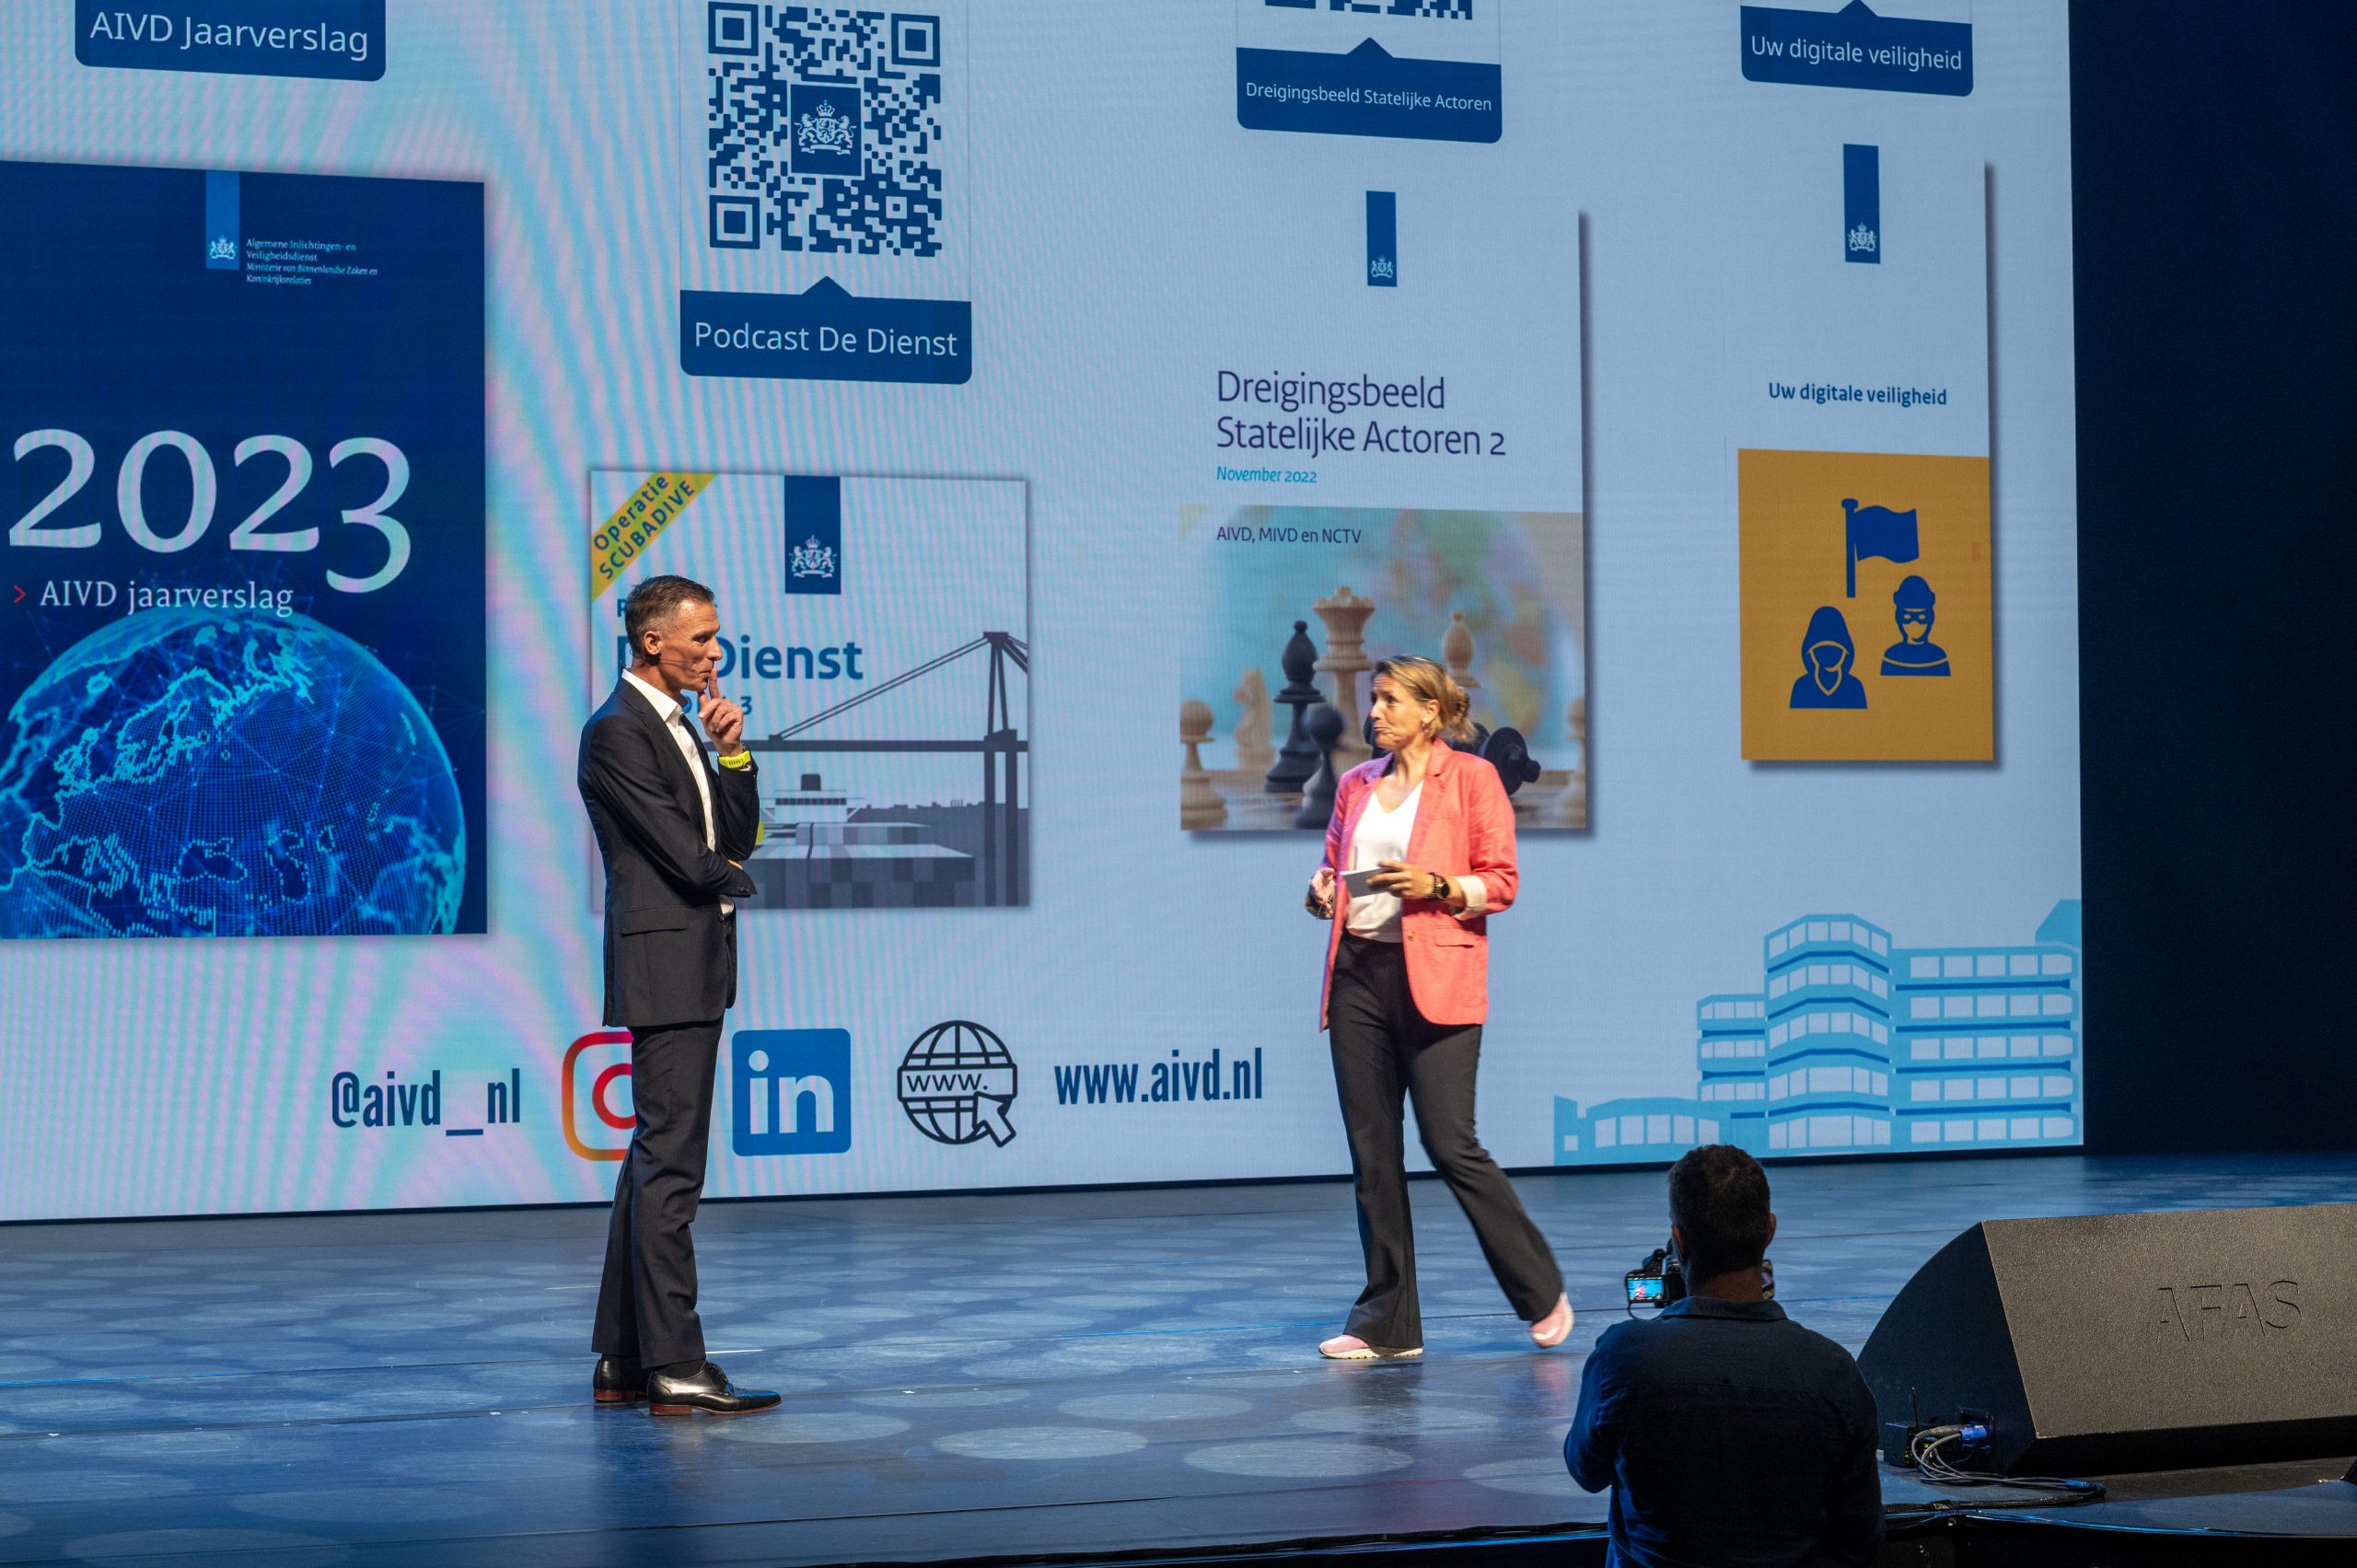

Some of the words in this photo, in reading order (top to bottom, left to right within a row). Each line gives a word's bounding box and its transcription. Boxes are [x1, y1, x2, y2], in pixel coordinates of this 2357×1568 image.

[89, 12, 173, 42] AIVD
[180, 17, 368, 61] Jaarverslag
[1751, 36, 1783, 56] Uw
[1789, 38, 1863, 65] digitale
[1868, 46, 1962, 72] veiligheid
[1246, 82, 1360, 103] Dreigingsbeeld
[1364, 89, 1431, 110] Statelijke
[1434, 95, 1492, 111] Actoren
[246, 238, 288, 250] Algemene
[345, 243, 357, 251] en
[246, 250, 318, 262] Veiligheidsdienst
[695, 322, 809, 351] Podcast
[819, 326, 857, 353] De
[867, 328, 958, 356] Dienst
[1218, 370, 1445, 413] Dreigingsbeeld
[1769, 382, 1795, 399] Uw
[1800, 383, 1863, 404] digitale
[1867, 387, 1946, 408] veiligheid
[1217, 416, 1355, 459] Statelijke
[1364, 421, 1480, 456] Actoren
[1489, 433, 1506, 456] 2
[1216, 466, 1282, 483] November
[1284, 470, 1318, 483] 2022
[8, 428, 412, 594] 2023
[594, 476, 668, 551] Operatie
[599, 481, 695, 580] SCUBADIVE
[1216, 527, 1256, 543] AIVD,
[1259, 528, 1298, 542] MIVD
[1301, 531, 1318, 543] en
[1322, 528, 1362, 543] NCTV
[40, 581, 117, 607] AIVD
[128, 581, 294, 617] jaarverslag
[907, 1073, 989, 1093] www.
[1054, 1047, 1263, 1106] www.aivd.nl
[2154, 1280, 2303, 1342] AFAS
